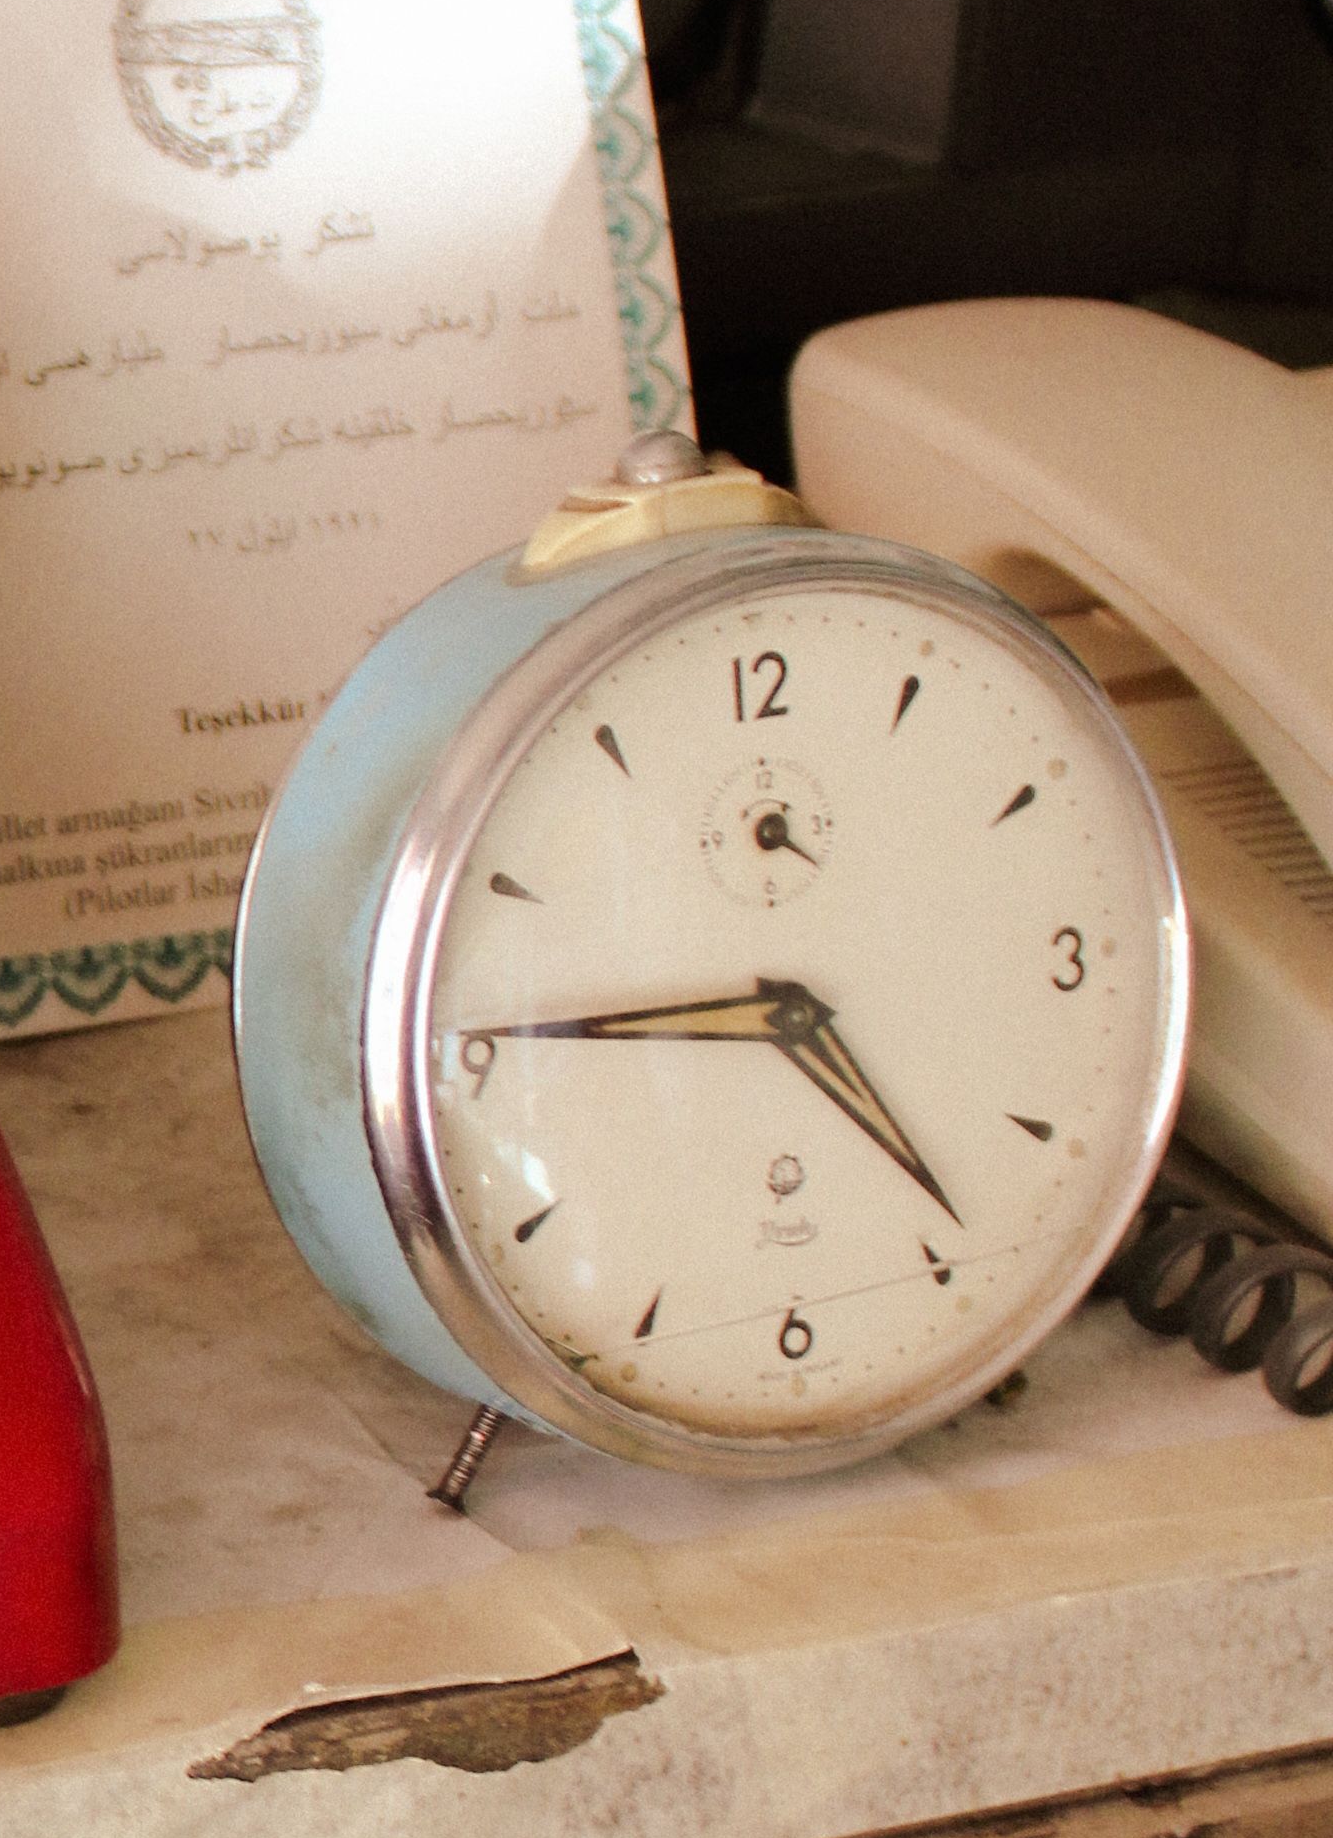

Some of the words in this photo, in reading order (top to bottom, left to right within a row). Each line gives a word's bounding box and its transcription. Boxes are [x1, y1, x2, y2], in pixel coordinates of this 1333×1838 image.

[732, 651, 789, 722] 12
[1051, 925, 1086, 993] 3
[459, 1028, 495, 1100] 9
[778, 1307, 814, 1361] 6
